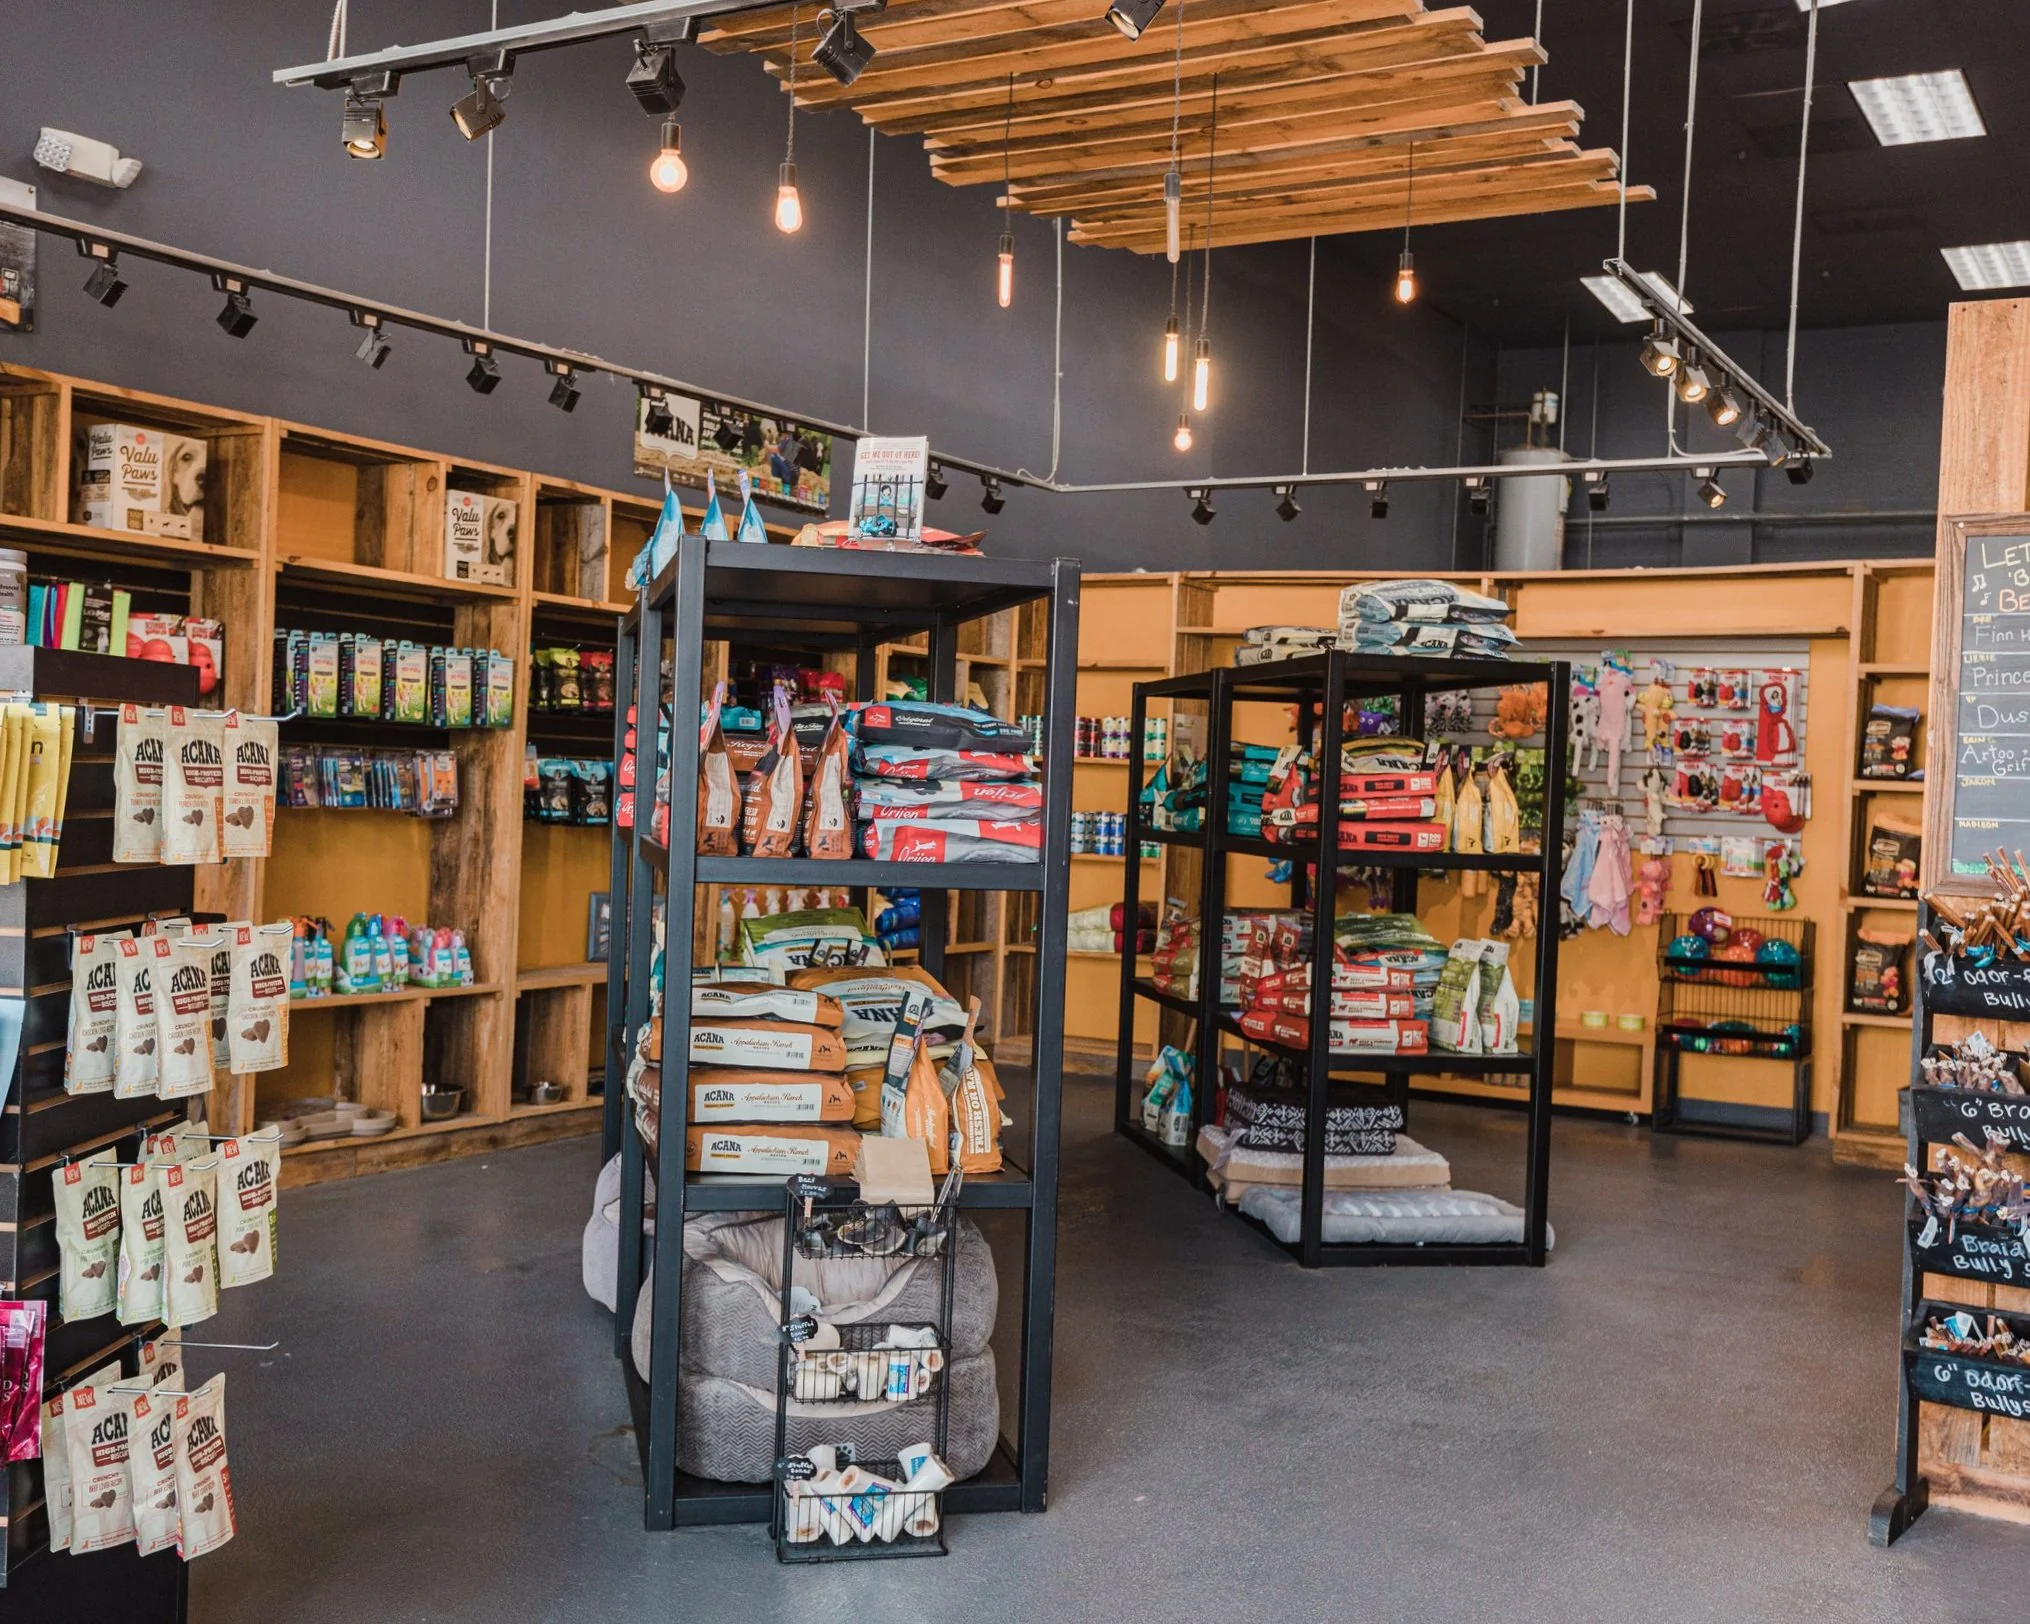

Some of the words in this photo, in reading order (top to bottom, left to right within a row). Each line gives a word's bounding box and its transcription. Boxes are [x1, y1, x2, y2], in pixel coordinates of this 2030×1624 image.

[120, 446, 158, 465] Valu
[860, 452, 872, 460] GET
[872, 451, 881, 459] ME
[882, 451, 894, 459] OUT
[895, 451, 902, 459] OF
[121, 464, 158, 481] Paws
[452, 508, 480, 522] Valu
[453, 523, 480, 536] Paws
[1975, 626, 2014, 645] Finn
[880, 800, 920, 819] Orijen
[250, 953, 282, 979] ACANA
[693, 1031, 725, 1045] ACANA
[703, 1088, 735, 1102] ACANA
[711, 1140, 742, 1153] ACANA
[83, 1185, 116, 1219] ACANA
[1953, 1255, 2013, 1280] Bully
[75, 1393, 94, 1406] NEW
[92, 1472, 120, 1484] CRUNCHY
